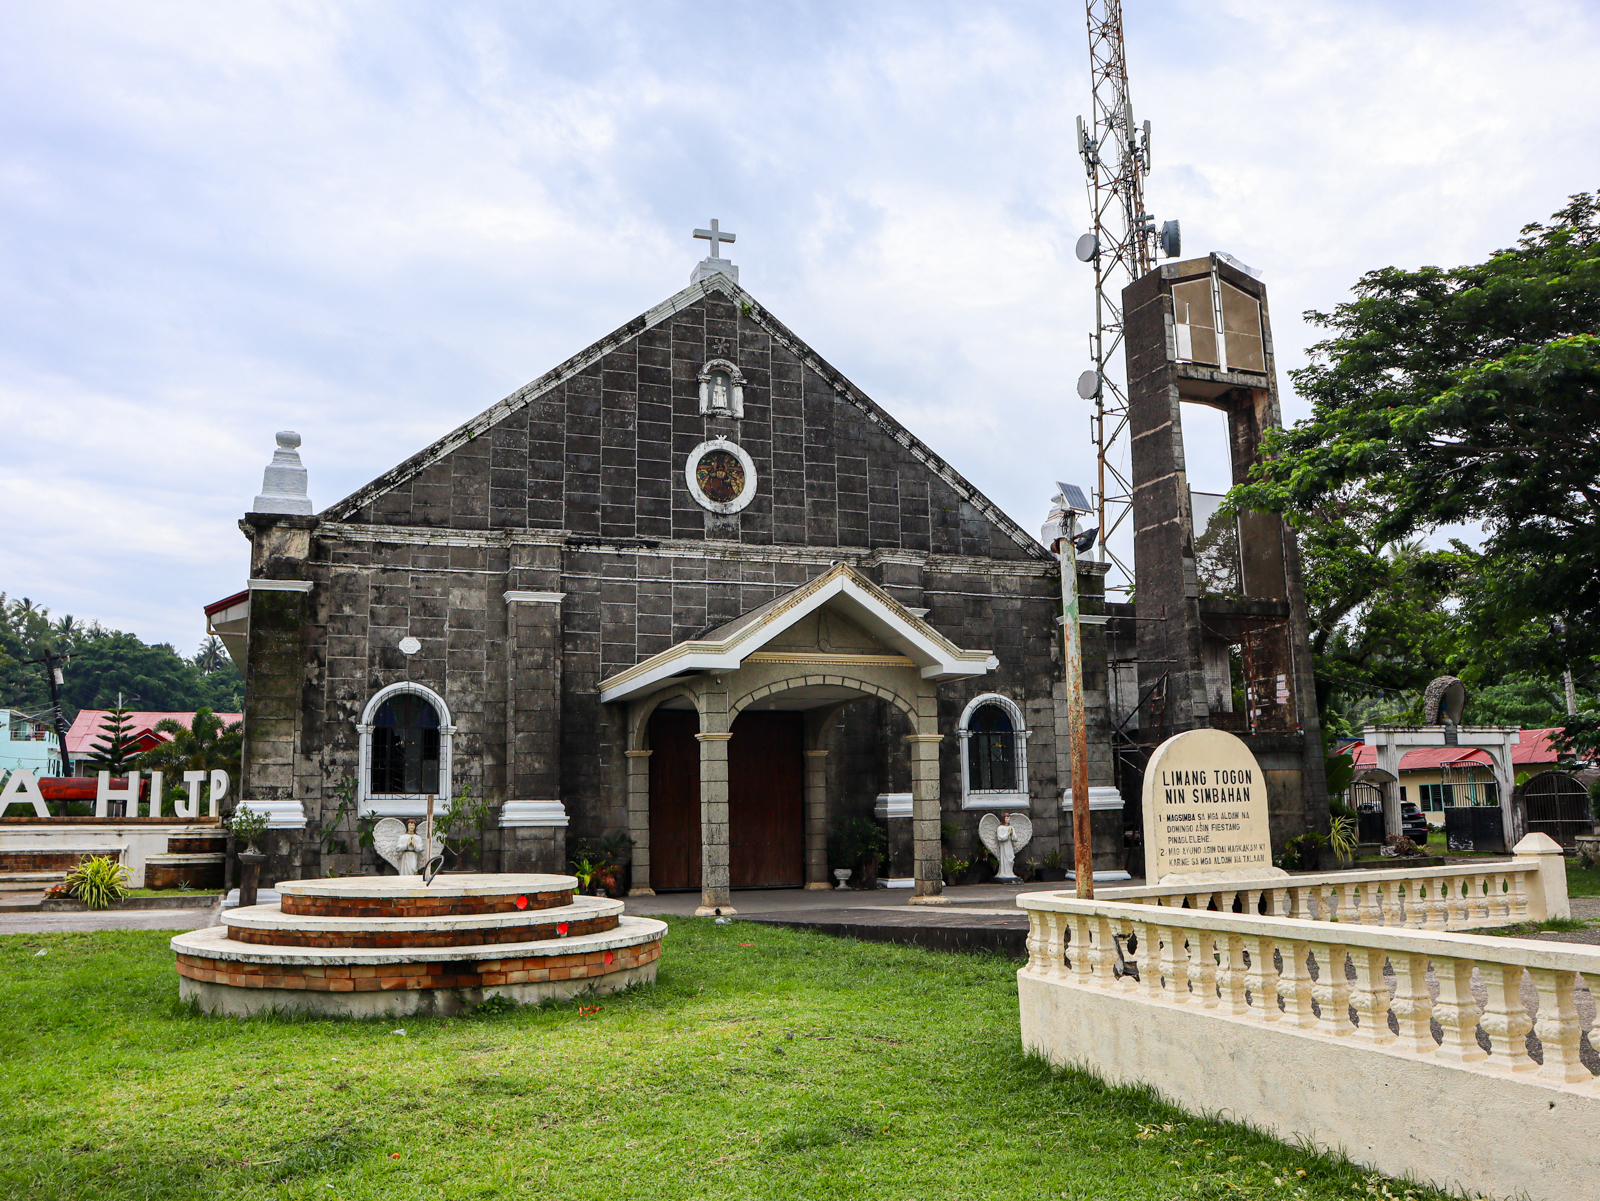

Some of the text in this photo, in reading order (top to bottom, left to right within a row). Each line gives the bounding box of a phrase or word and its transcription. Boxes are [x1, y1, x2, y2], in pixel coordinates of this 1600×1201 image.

[1162, 769, 1252, 786] LIMANG TOGON
[0, 769, 51, 817] A
[1165, 786, 1250, 804] NIN SIMBAHAN
[1166, 813, 1196, 822] MAGSIMBA
[1197, 813, 1205, 821] SA
[1207, 812, 1219, 820] MGA
[1220, 811, 1240, 820] ALDAW
[1241, 811, 1250, 819] NA
[1166, 823, 1241, 834] DOMINGO ASIN FIESTANG
[1182, 846, 1202, 855] AYUNO
[1203, 845, 1216, 854] ASIN
[1217, 845, 1227, 853] DAI
[1169, 857, 1190, 866] KARNE
[1191, 857, 1199, 866] SA
[1200, 857, 1212, 865] MGA
[1233, 855, 1242, 863] NA
